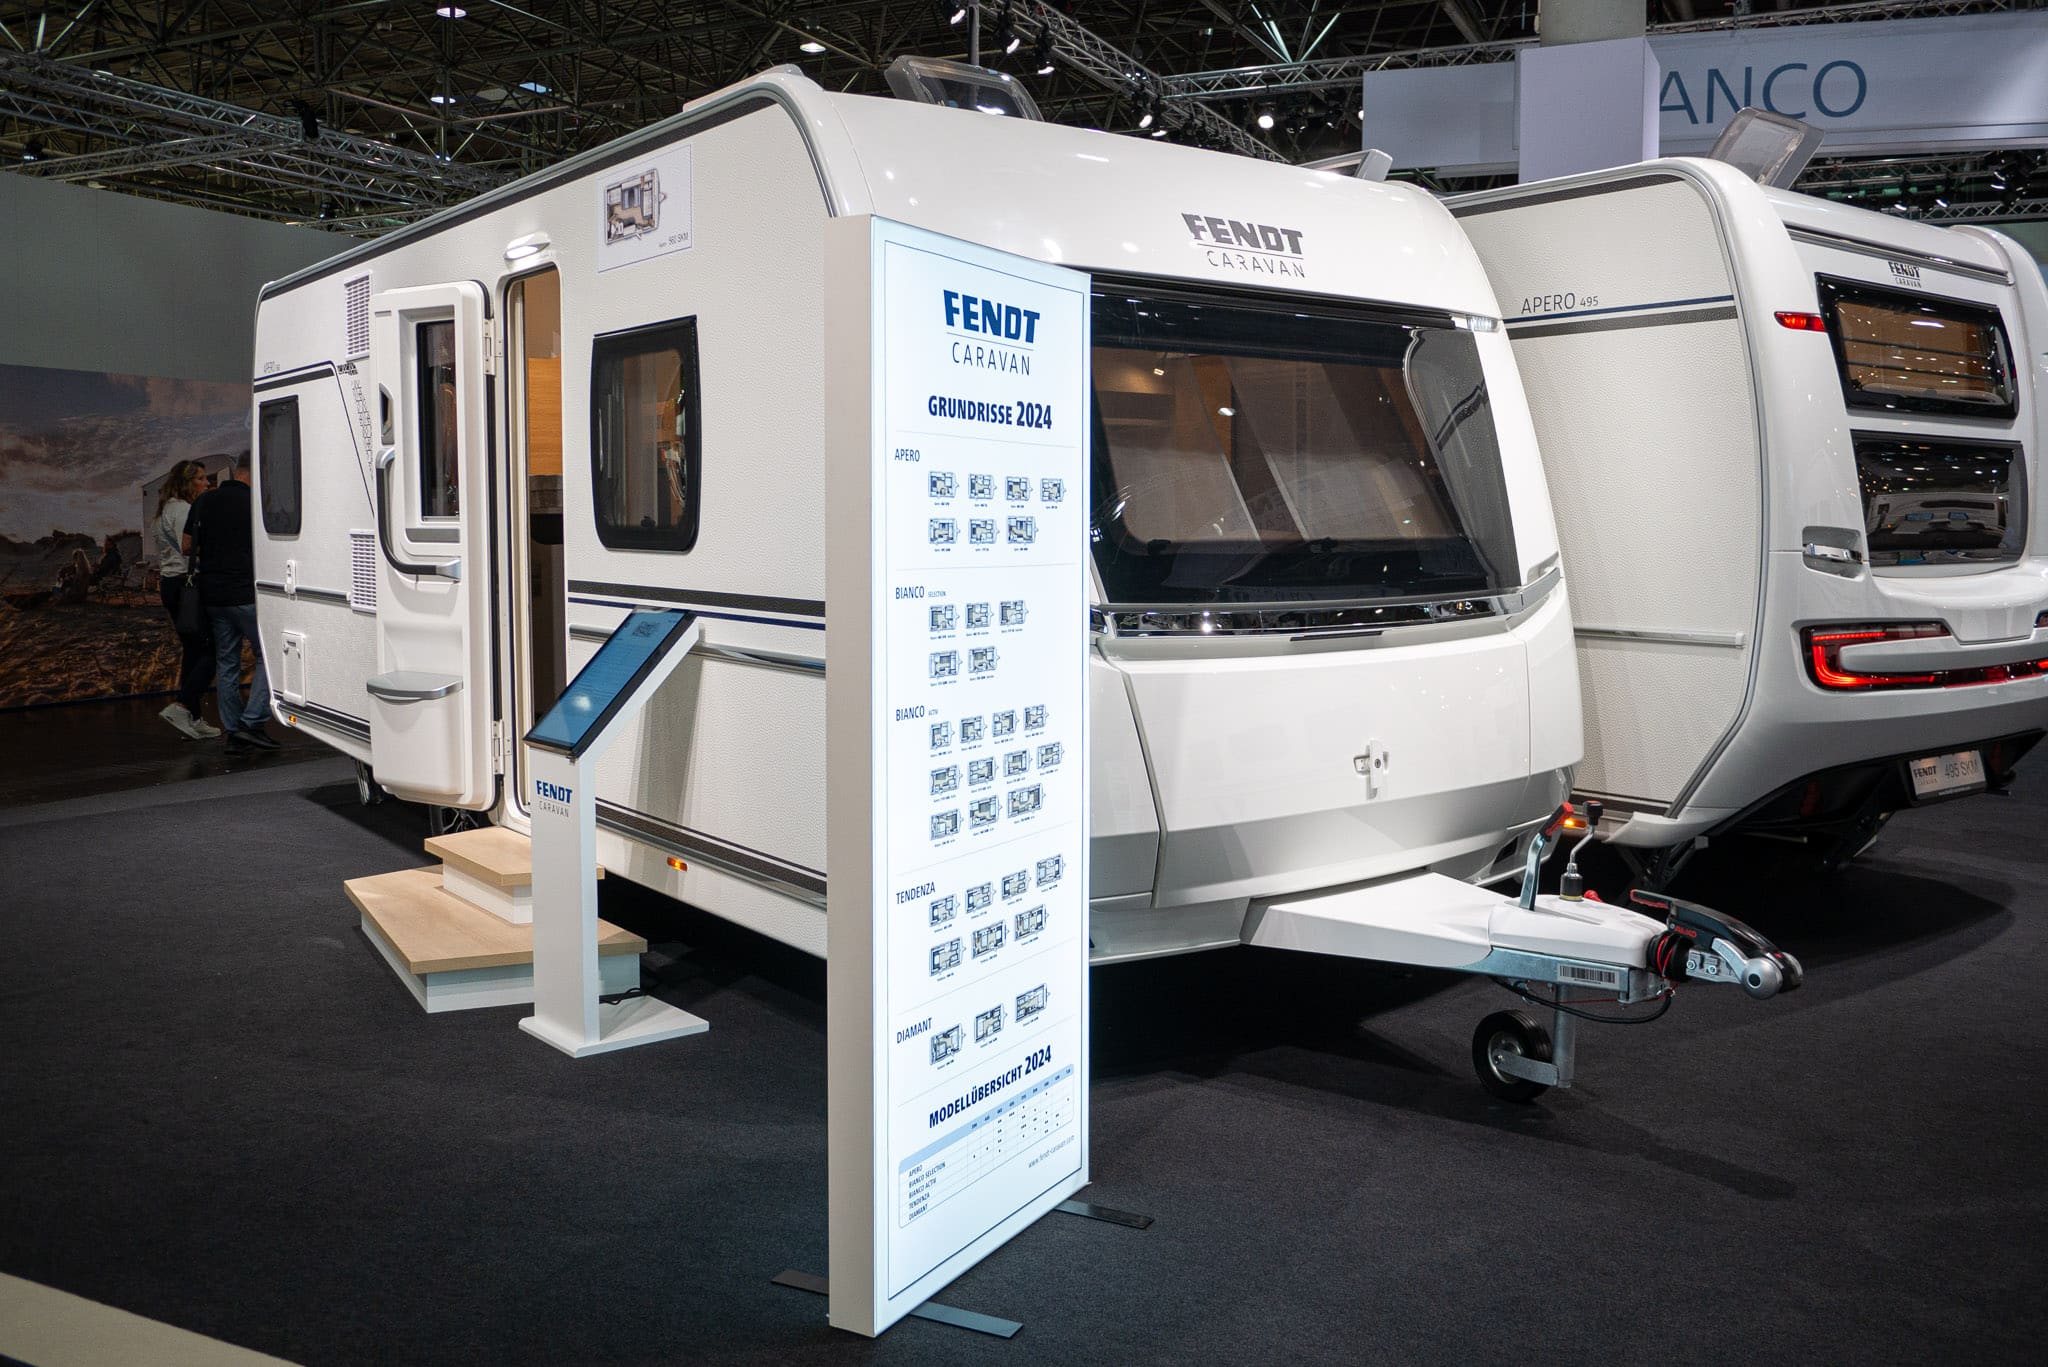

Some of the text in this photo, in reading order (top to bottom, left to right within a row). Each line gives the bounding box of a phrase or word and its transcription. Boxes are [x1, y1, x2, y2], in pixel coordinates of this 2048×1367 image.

[1181, 212, 1303, 255] FENDT
[1207, 250, 1305, 278] CARAVAN
[1888, 261, 1920, 278] FENDT
[1895, 277, 1921, 288] CARAVAN
[1521, 292, 1599, 314] APERO 495
[943, 289, 1040, 344] FENDT
[952, 342, 1031, 376] CARAVAN
[928, 395, 1052, 430] GRUNDRISSE 2024
[894, 448, 921, 462] APERO
[895, 586, 925, 600] BIANCO
[895, 705, 925, 722] BIANCO
[1913, 765, 1937, 778] FENDT
[1944, 762, 1960, 779] 495
[536, 780, 573, 804] FENDT
[539, 800, 569, 818] CARAVAN
[896, 881, 936, 905] TENDENZA
[896, 1017, 933, 1044] DIAMANT
[929, 1065, 1022, 1129] MODELLÜBERSICHT
[1024, 1045, 1051, 1076] 2024
[909, 1164, 923, 1178] APERO
[909, 1203, 928, 1221] DIAMANT
